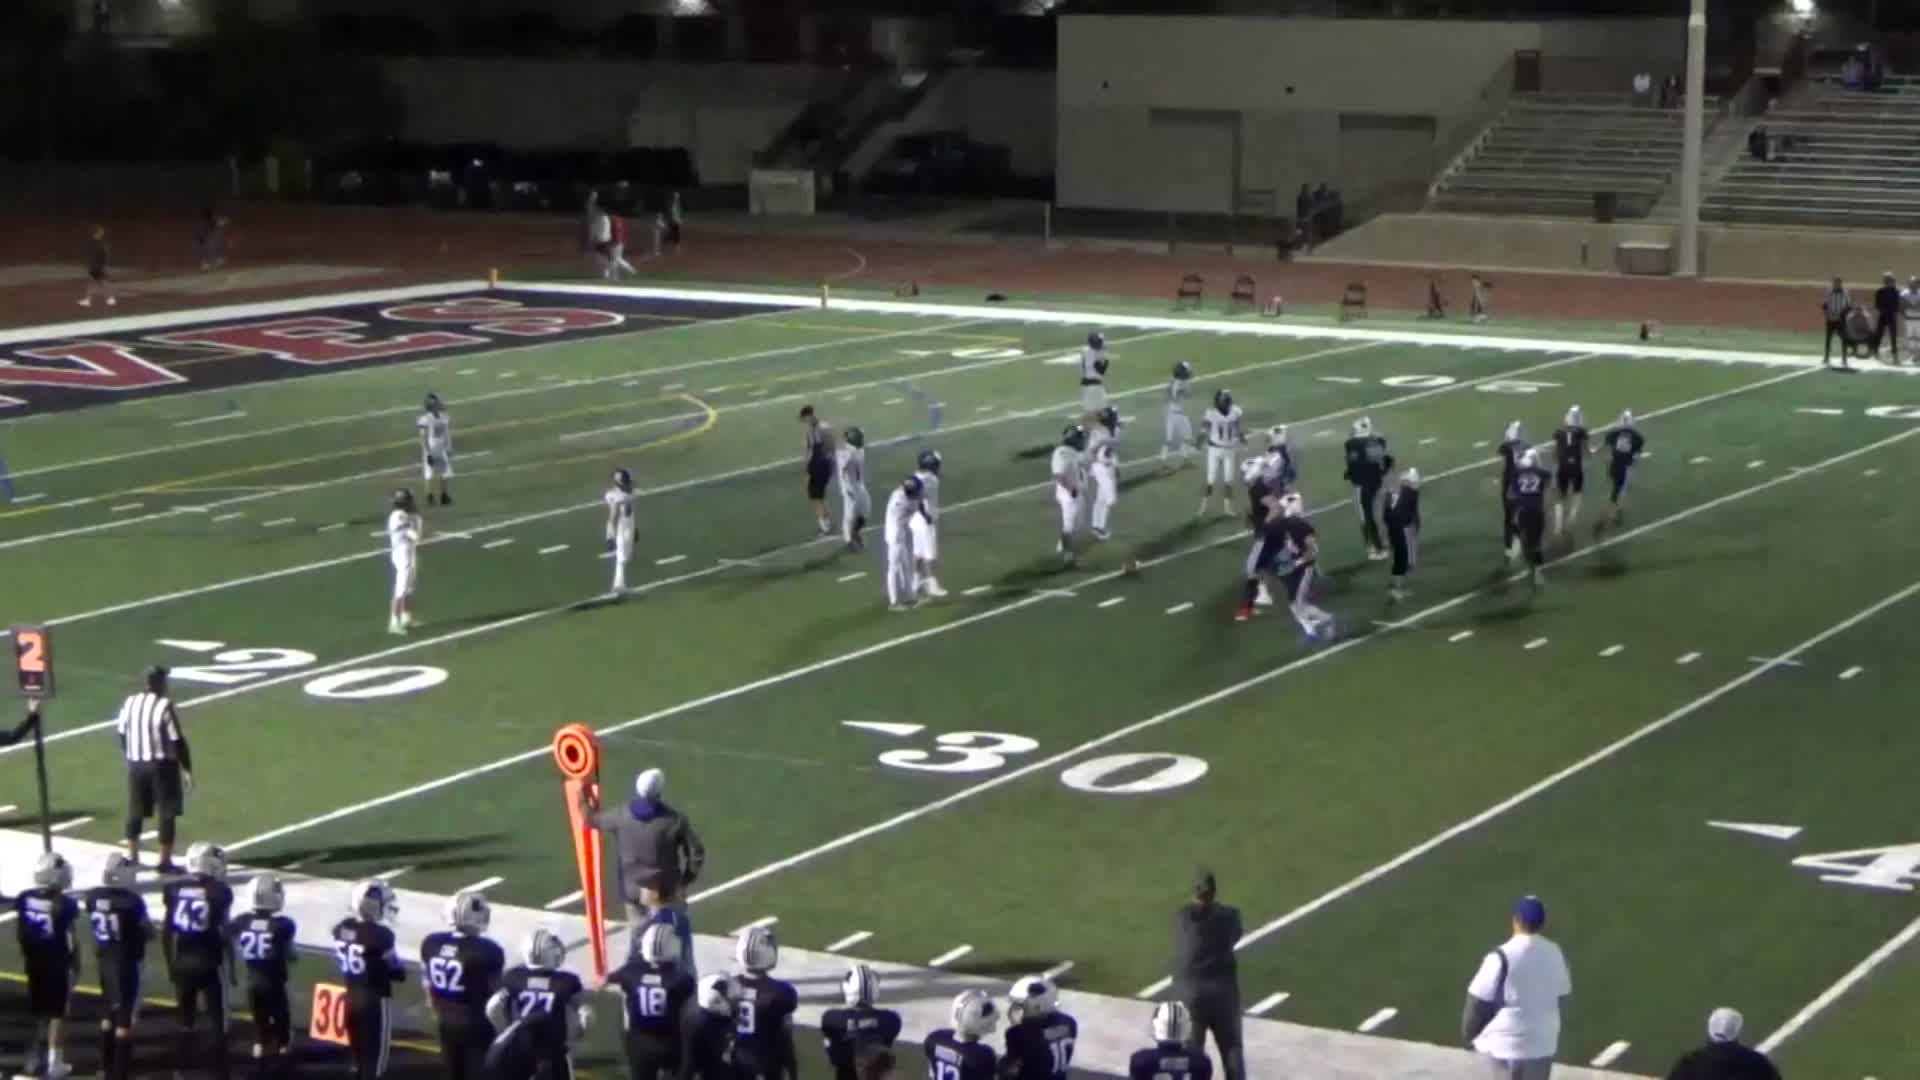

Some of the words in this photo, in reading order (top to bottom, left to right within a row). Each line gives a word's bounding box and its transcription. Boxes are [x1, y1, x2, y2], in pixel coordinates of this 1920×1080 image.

[0, 298, 625, 408] VES
[18, 632, 44, 671] 2
[174, 899, 209, 931] 43
[336, 941, 366, 974] 56
[430, 957, 464, 992] 62
[315, 988, 347, 1038] 30
